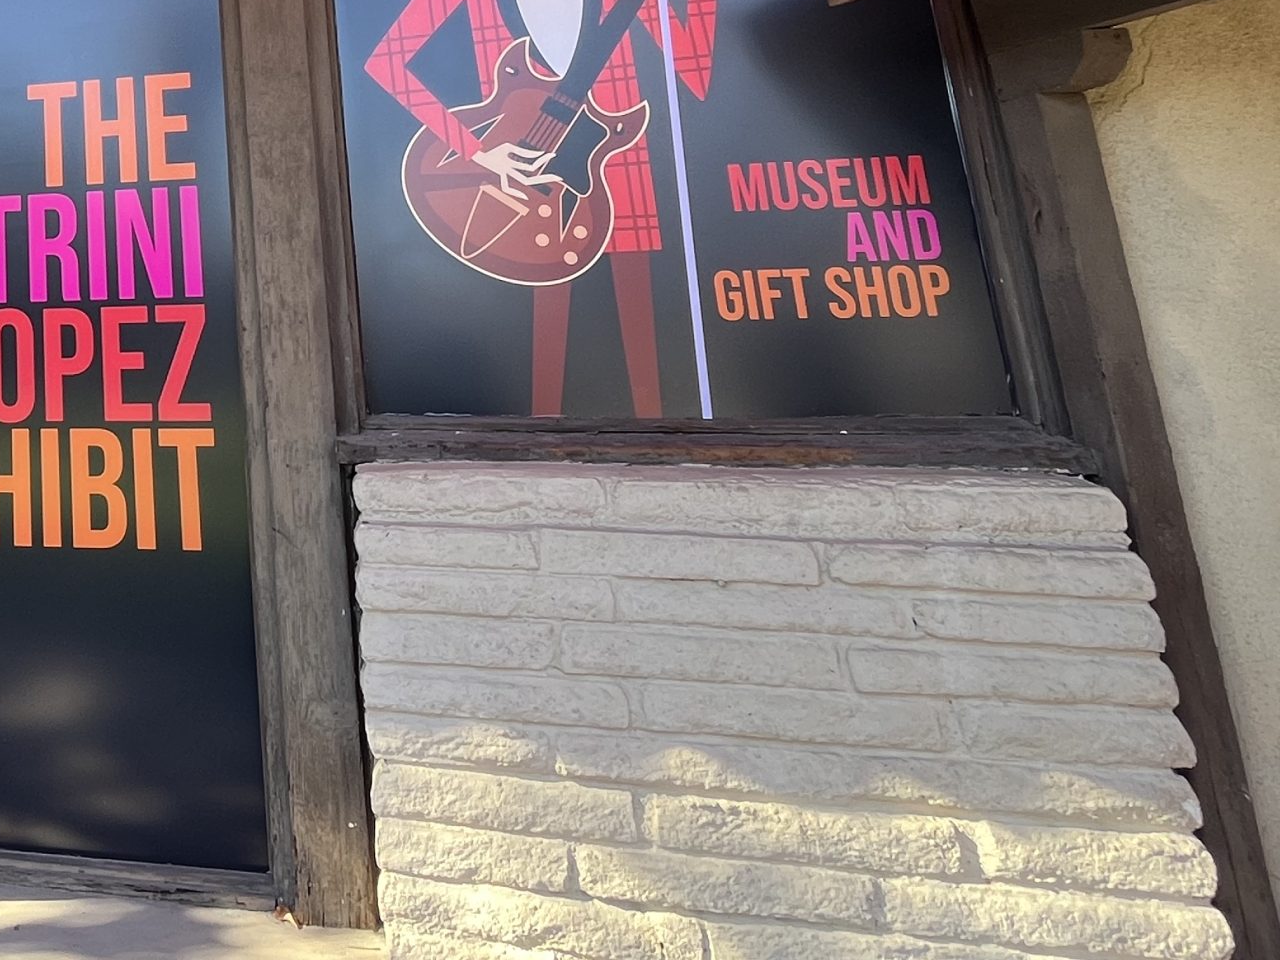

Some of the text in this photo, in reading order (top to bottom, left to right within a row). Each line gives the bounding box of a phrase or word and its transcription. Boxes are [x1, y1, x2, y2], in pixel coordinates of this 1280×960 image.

[27, 72, 196, 187] THE
[727, 154, 931, 212] MUSEUM
[847, 209, 942, 262] AND
[713, 264, 950, 321] GIFT SHOP
